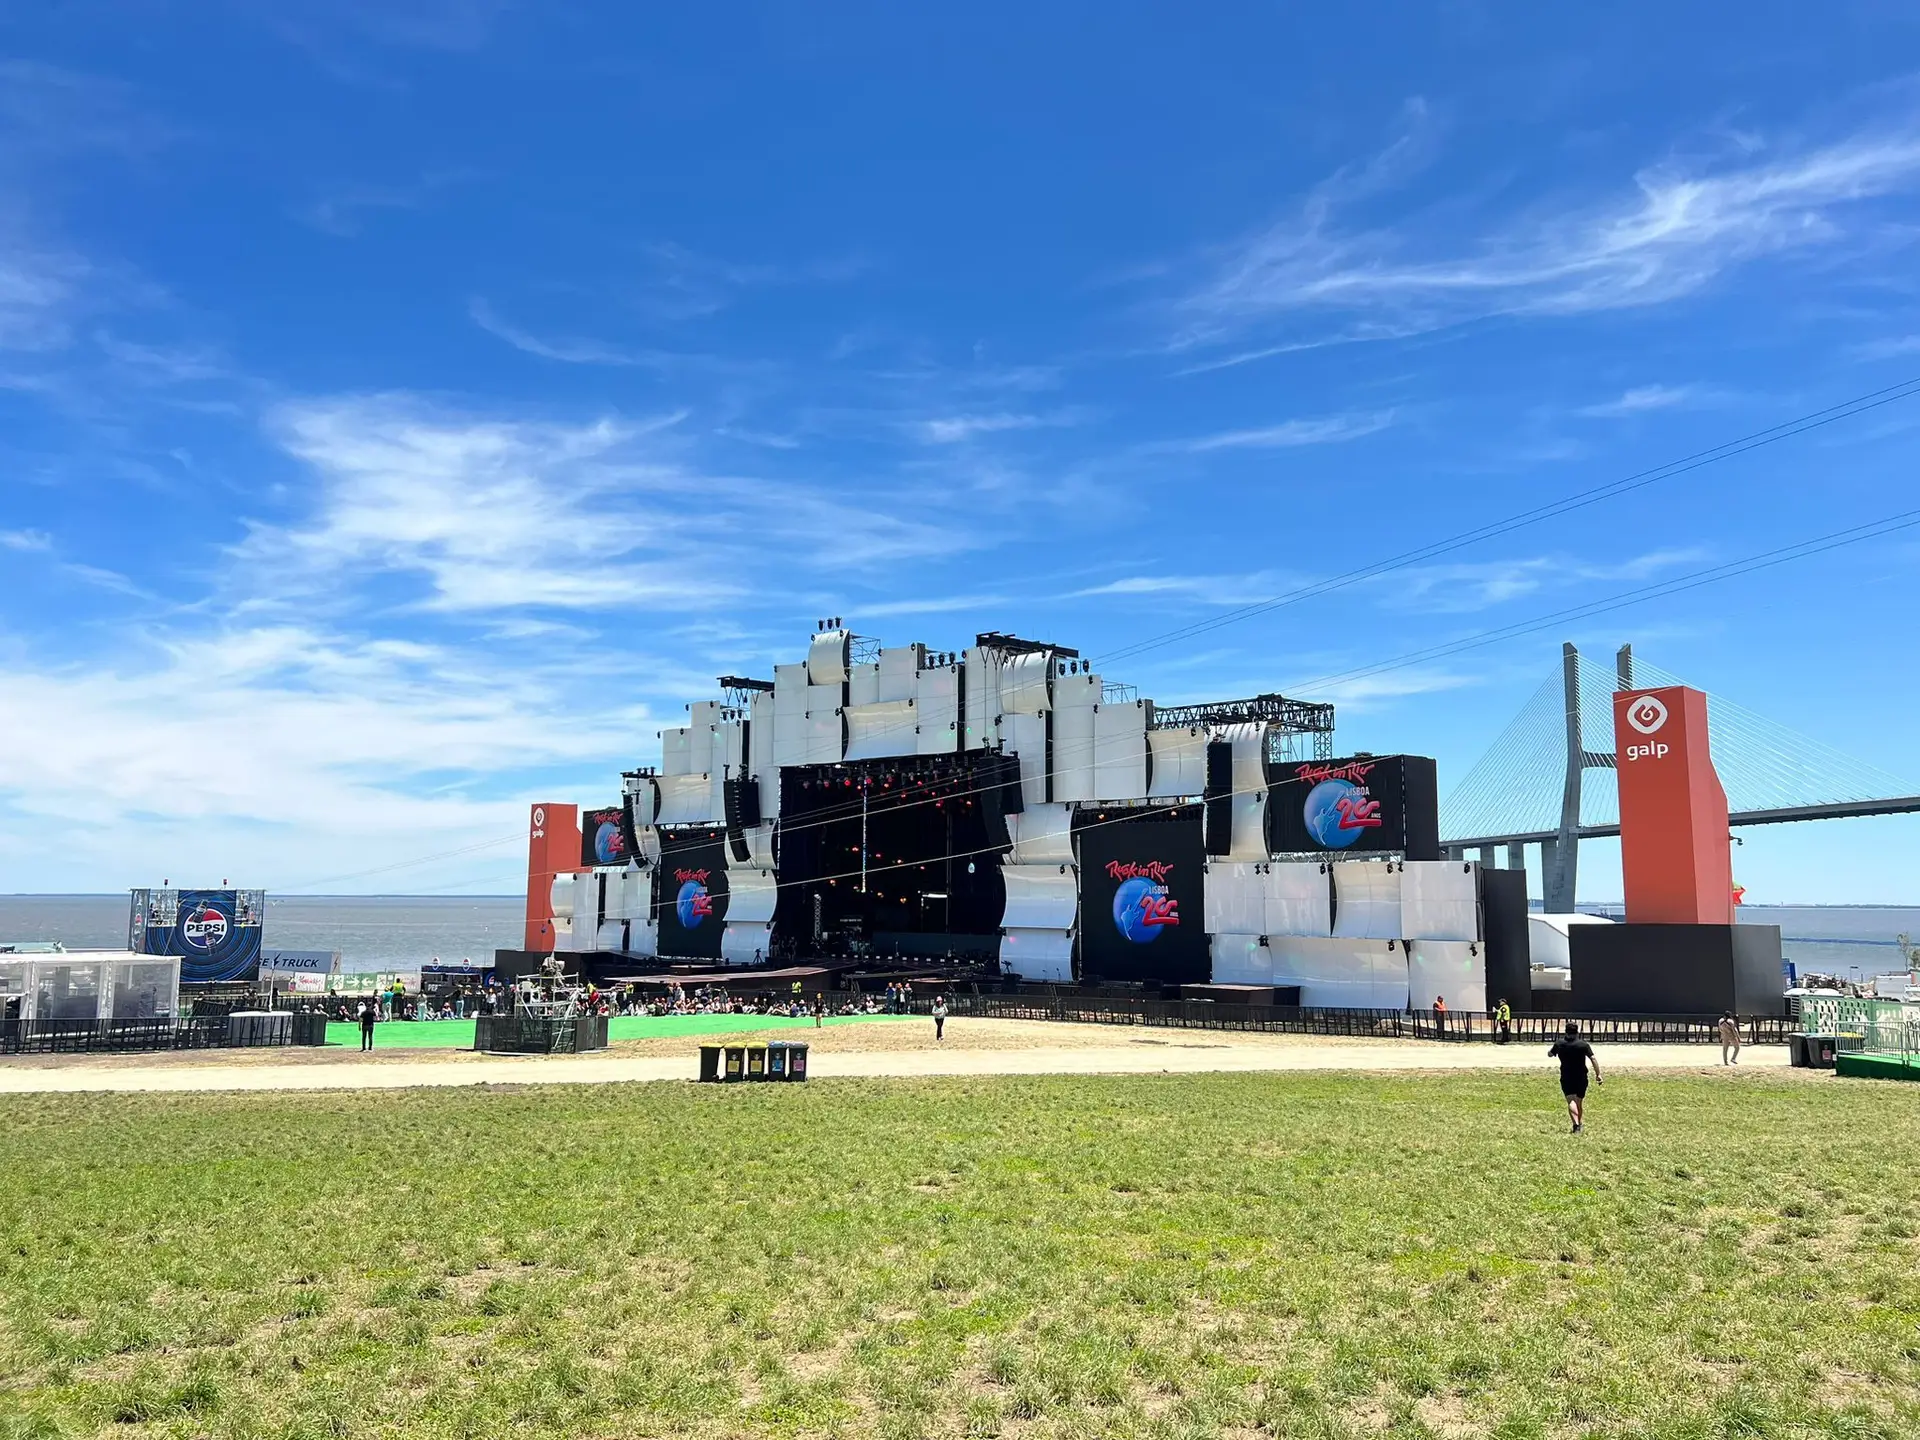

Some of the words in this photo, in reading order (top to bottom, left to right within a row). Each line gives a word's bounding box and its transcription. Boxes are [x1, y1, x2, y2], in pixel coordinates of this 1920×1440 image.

[1626, 740, 1669, 761] galp
[1294, 763, 1334, 786] Rock
[1344, 762, 1375, 784] Rio
[1345, 786, 1370, 796] LISBOA
[1105, 860, 1139, 882] Rock
[1147, 860, 1174, 883] Rio
[1148, 885, 1169, 895] LISBOA
[186, 923, 225, 933] PEPSI
[282, 958, 320, 968] TRUCK
